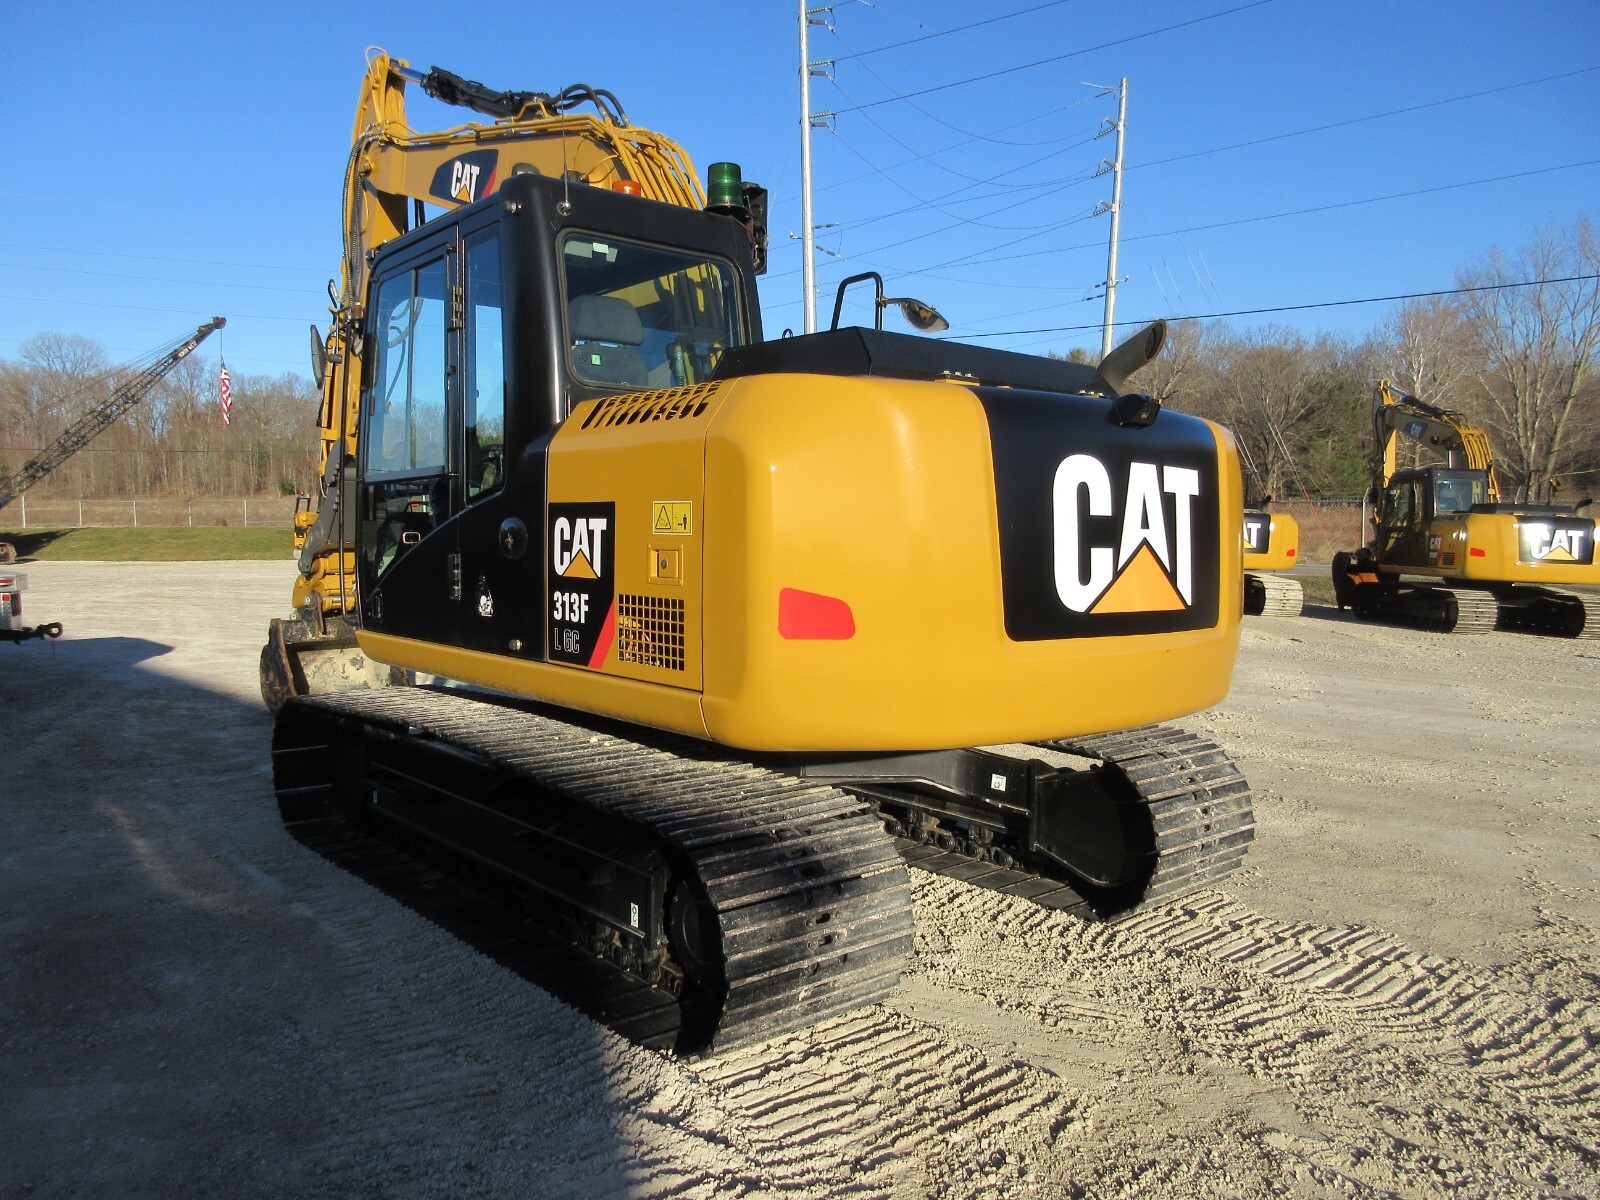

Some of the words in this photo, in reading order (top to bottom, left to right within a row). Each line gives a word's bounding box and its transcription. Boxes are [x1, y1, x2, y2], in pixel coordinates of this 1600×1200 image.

[451, 160, 480, 203] CAT
[553, 516, 607, 579] CAT
[1052, 454, 1199, 613] CAT
[1530, 527, 1584, 561] CAT
[553, 590, 589, 624] 313F
[554, 627, 561, 651] L
[563, 628, 580, 654] GC
